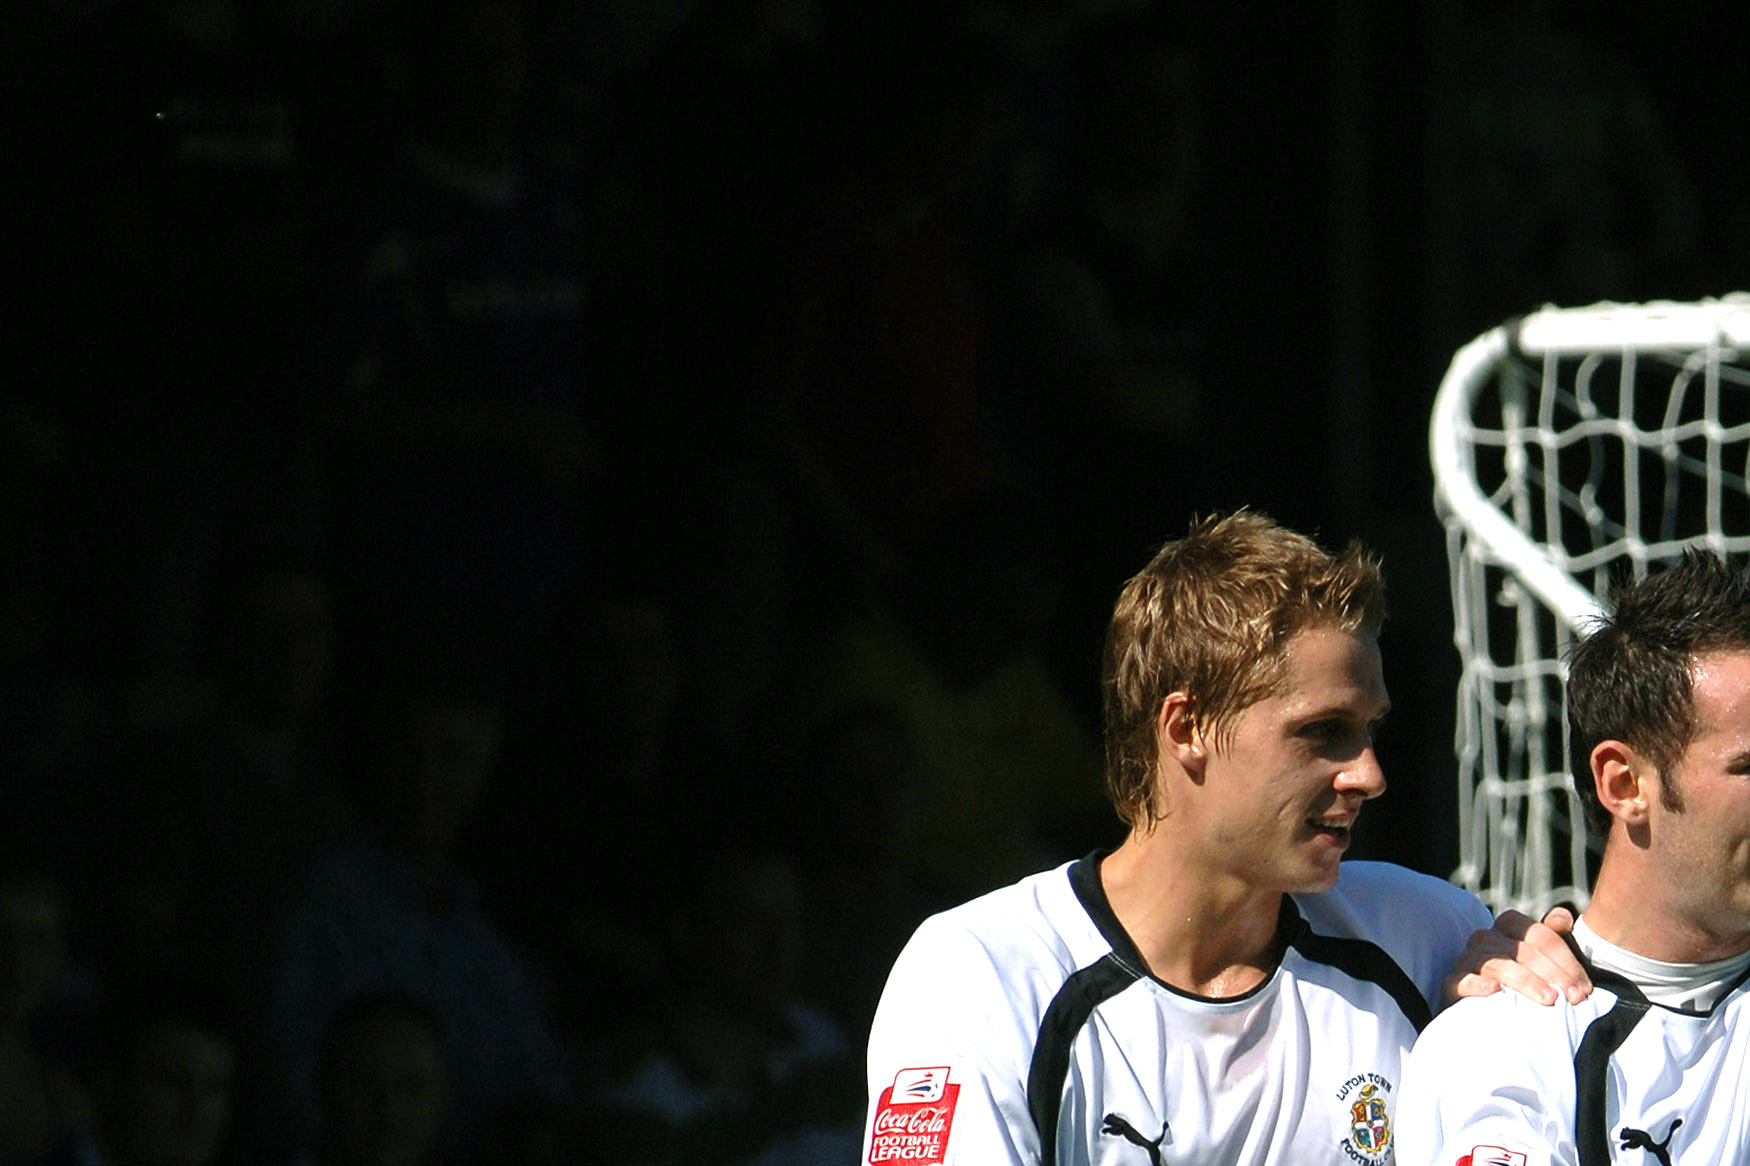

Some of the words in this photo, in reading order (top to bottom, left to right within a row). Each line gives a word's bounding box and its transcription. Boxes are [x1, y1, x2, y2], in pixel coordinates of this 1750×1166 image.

[1336, 1073, 1366, 1101] LUTON
[1367, 1072, 1392, 1093] TOWN
[875, 1107, 949, 1135] Coca-Cola
[874, 1134, 941, 1148] FOOTBALL
[871, 1145, 940, 1162] LEAGUE
